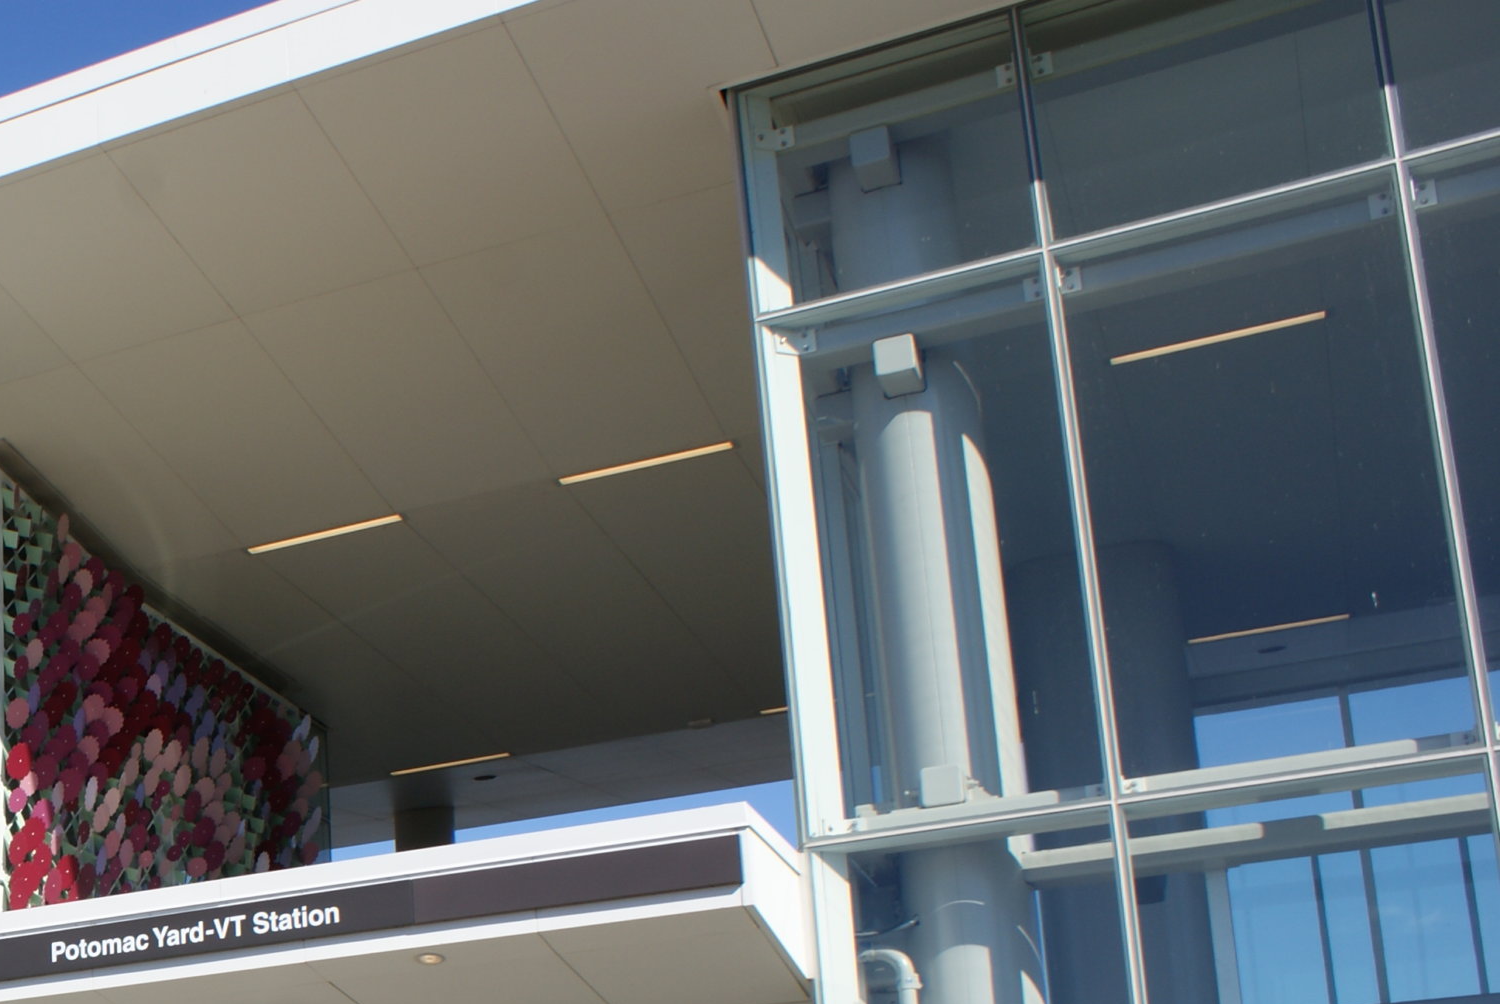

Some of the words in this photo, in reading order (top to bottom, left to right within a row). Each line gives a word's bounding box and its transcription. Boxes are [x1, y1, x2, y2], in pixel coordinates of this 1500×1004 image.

[50, 932, 149, 963] Potomac
[152, 915, 246, 948] Yard-VT
[252, 905, 340, 935] Station
